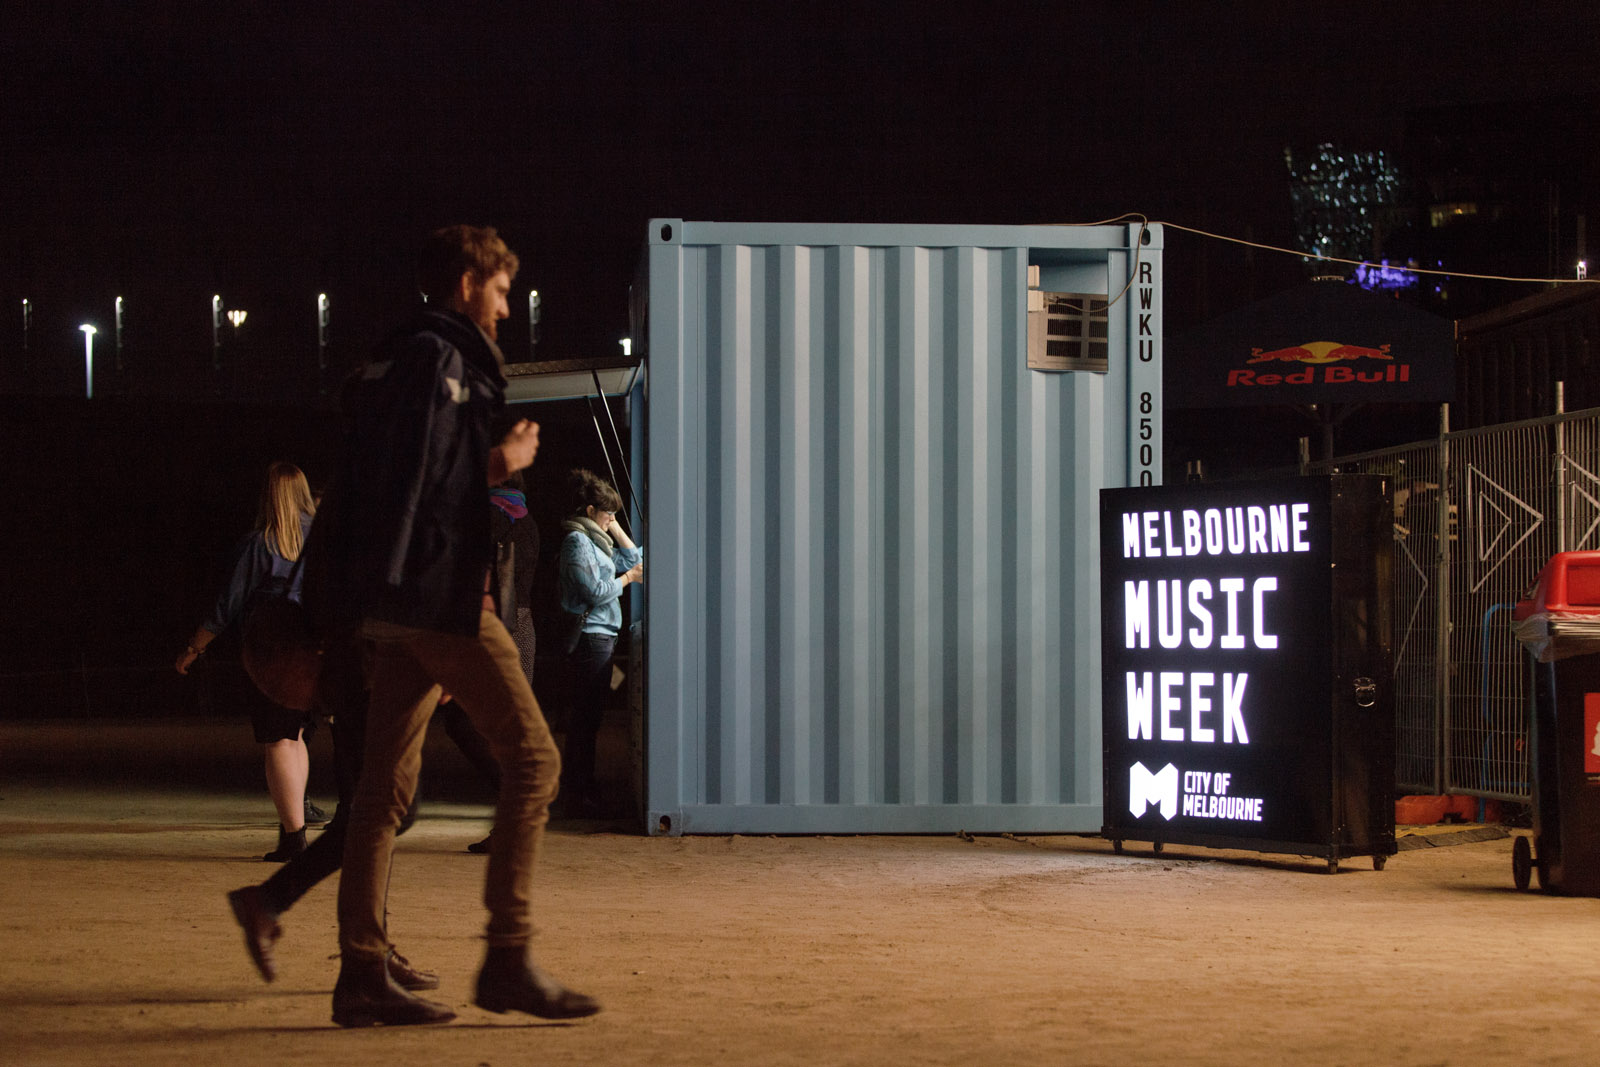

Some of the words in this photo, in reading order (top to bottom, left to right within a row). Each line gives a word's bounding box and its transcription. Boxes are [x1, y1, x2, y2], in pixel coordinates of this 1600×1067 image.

[1139, 262, 1153, 362] RWKU
[1227, 367, 1315, 387] Red
[1325, 364, 1410, 384] Bull
[1122, 503, 1310, 558] MELBOURNE
[1124, 577, 1278, 649] MUSIC
[1126, 672, 1249, 744] WEEK
[1182, 795, 1263, 822] MELBOURNE
[1183, 771, 1211, 794] CITY
[1213, 772, 1231, 795] OF
